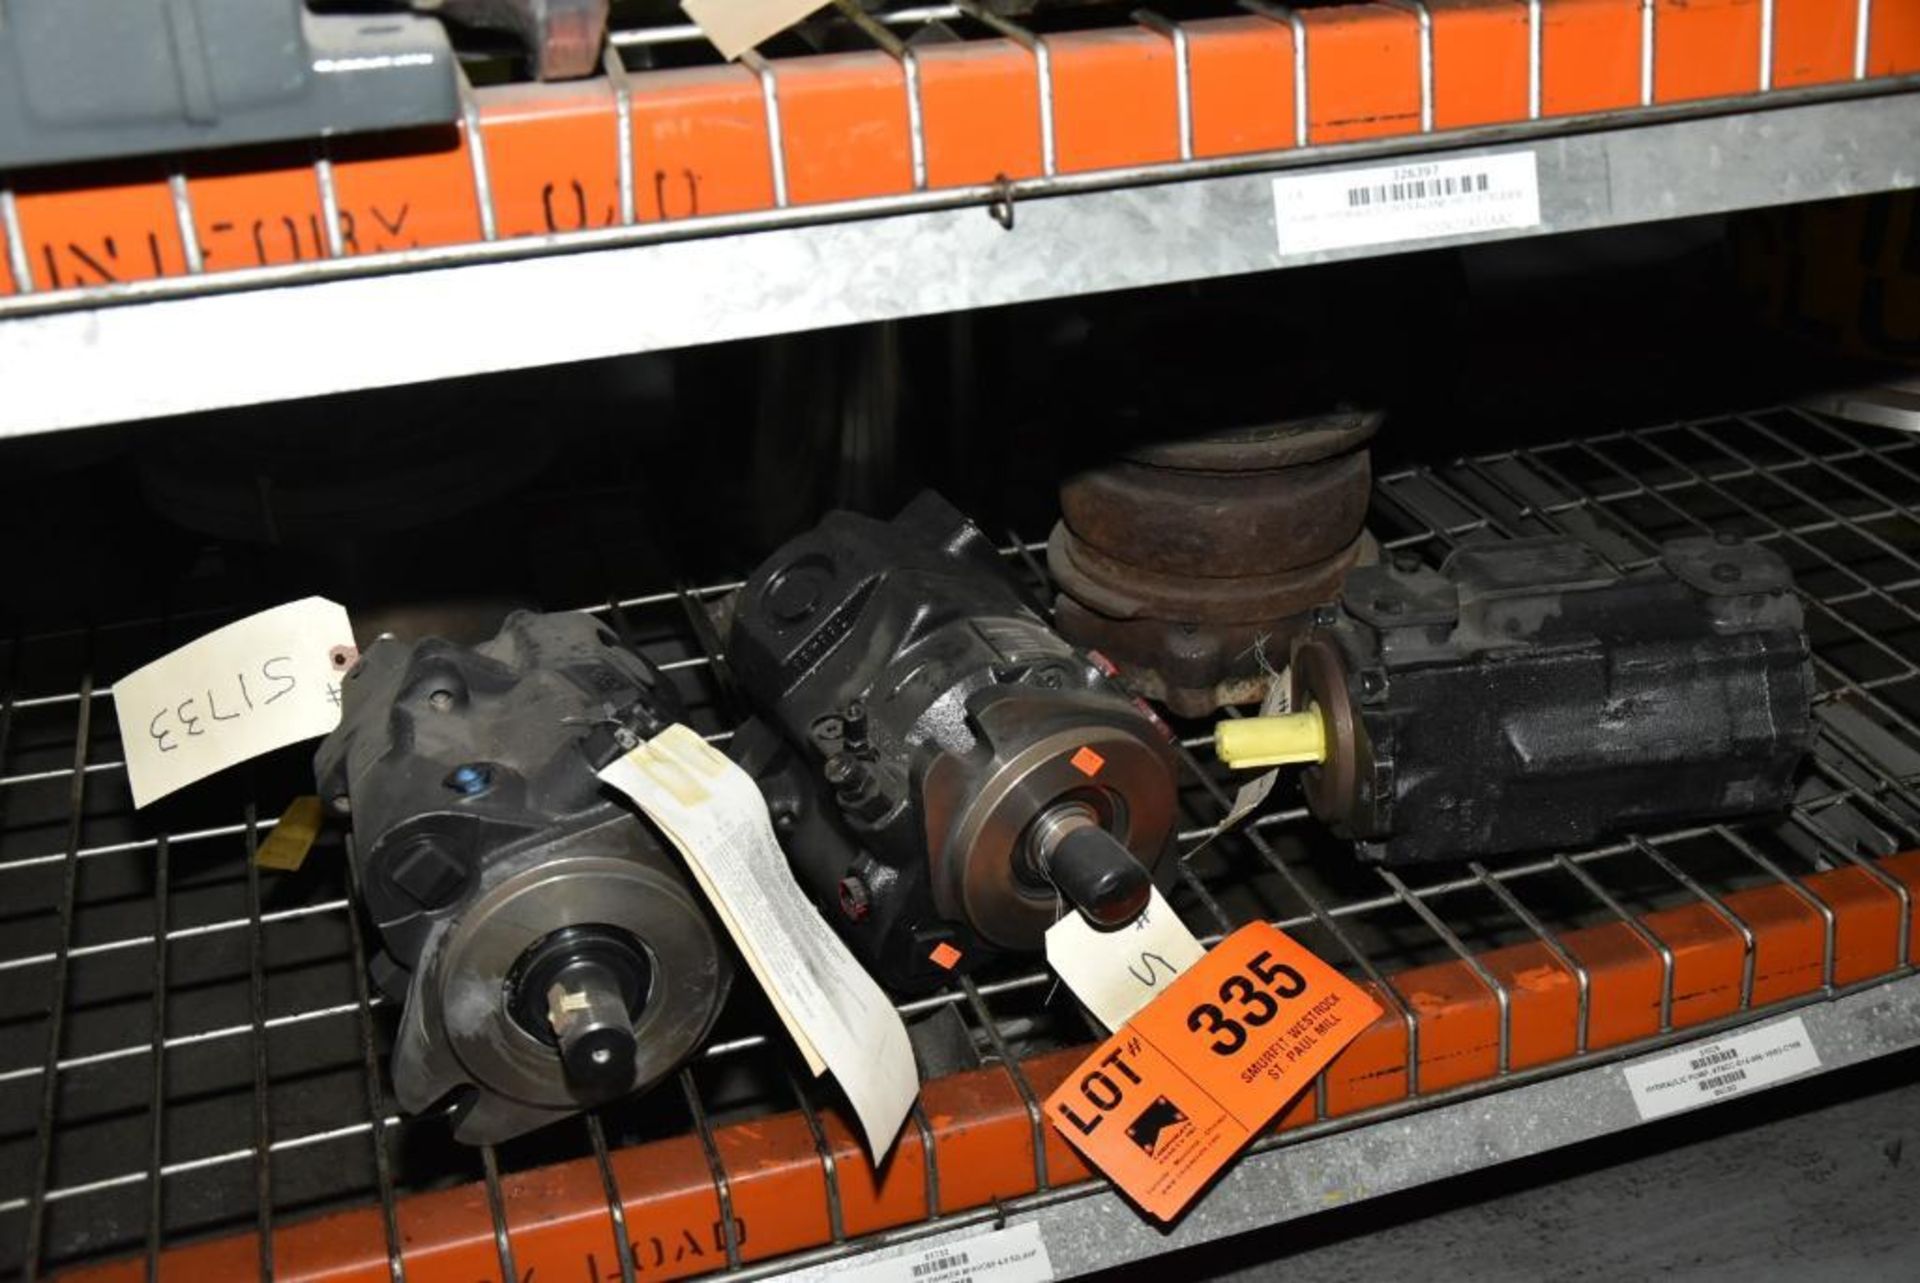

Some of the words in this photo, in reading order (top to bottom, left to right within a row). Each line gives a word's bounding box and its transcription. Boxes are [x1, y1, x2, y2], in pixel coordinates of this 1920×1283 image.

[1186, 950, 1307, 1057] 335
[1239, 1036, 1290, 1084] SMURFIT
[1287, 992, 1341, 1039] WESTROCK
[1286, 1034, 1318, 1062] PAUL
[1315, 1014, 1341, 1036] MILL
[585, 1216, 747, 1282] LOAD
